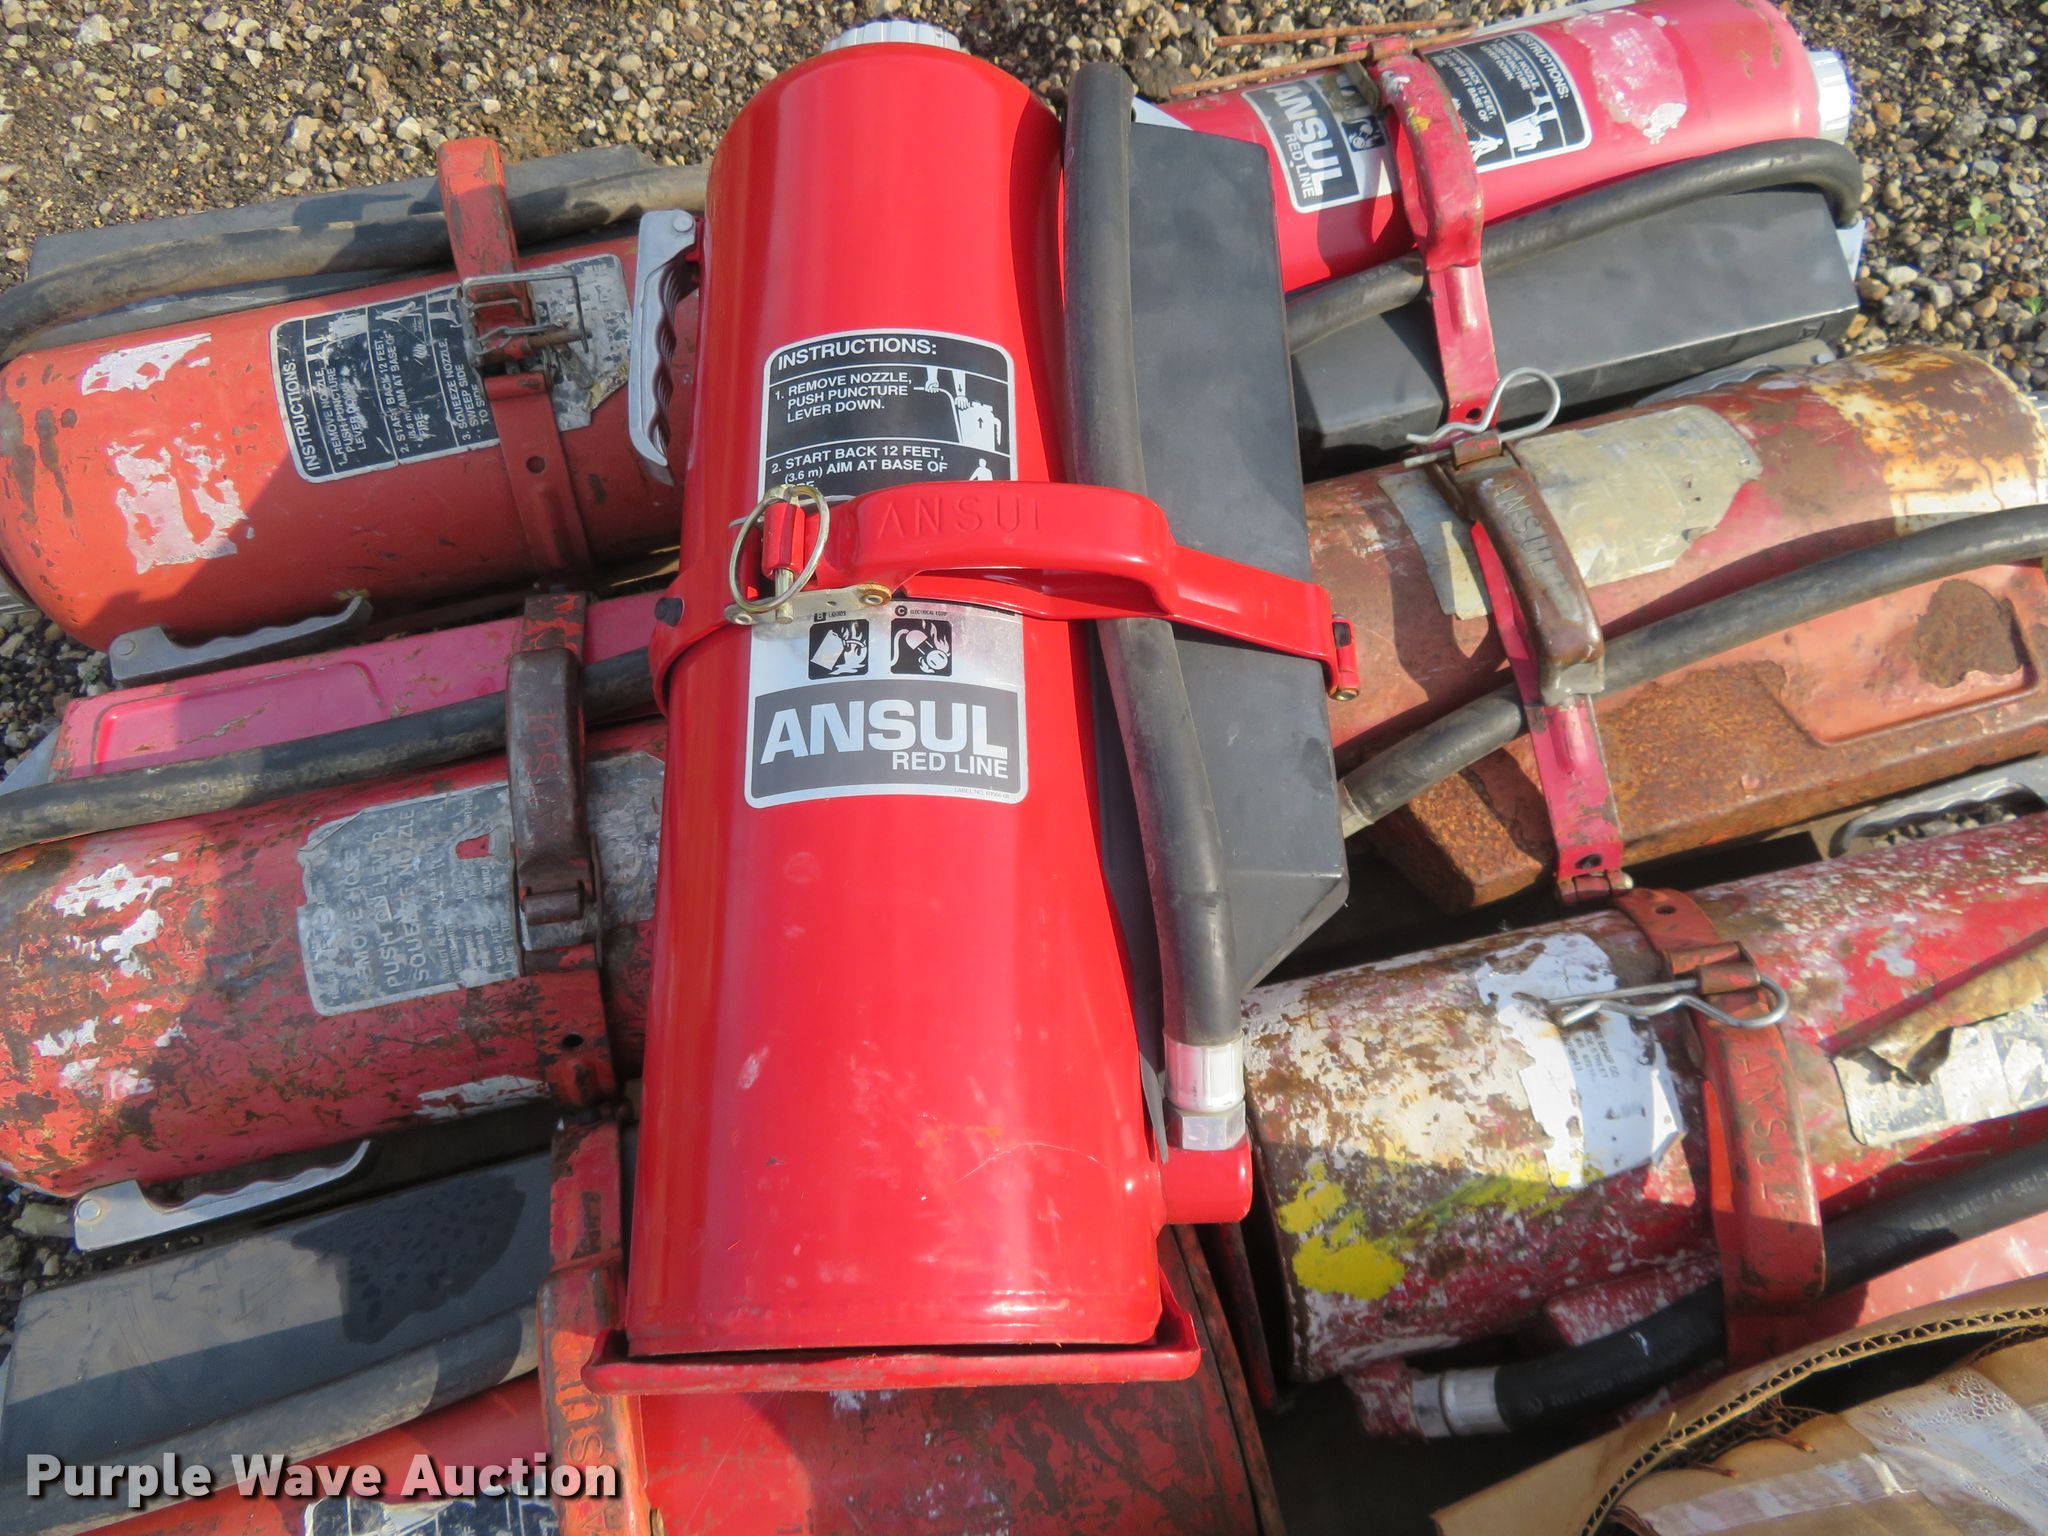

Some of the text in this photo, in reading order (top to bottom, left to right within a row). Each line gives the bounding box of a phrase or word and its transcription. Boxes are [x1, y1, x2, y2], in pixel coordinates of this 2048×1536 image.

[1478, 109, 1490, 122] OF
[1265, 86, 1343, 196] ANSUL
[1284, 133, 1315, 199] RED LINE
[385, 330, 395, 345] OF
[379, 362, 388, 373] 12
[387, 345, 399, 372] BASE
[778, 337, 937, 371] INSTRUCTIONS:
[393, 373, 402, 388] AT
[455, 363, 479, 427] SWEEP SIDE
[774, 372, 913, 400] 1. REMOVE NOZZLE,
[327, 367, 355, 453] PUSH PUNCTURE
[447, 380, 468, 430] SQUEEZE
[787, 385, 908, 410] PUSH PUNCTURE
[787, 399, 885, 423] LEVER DOWN.
[283, 358, 321, 471] INSTRUCTIONS:
[479, 409, 490, 425] TO
[324, 410, 342, 456] REMOVE
[350, 413, 367, 450] LEVER
[462, 430, 472, 441] 3.
[400, 443, 410, 453] 2.
[771, 445, 944, 474] 2. START BACK 12 FEET,
[784, 460, 948, 485] (3.6 m) AIM AT BASE OF
[760, 699, 1008, 765] ANSUL
[892, 751, 1009, 779] RED LINE
[398, 809, 416, 875] NOZLE
[371, 831, 390, 888] LEVR
[380, 930, 404, 989] PUSH
